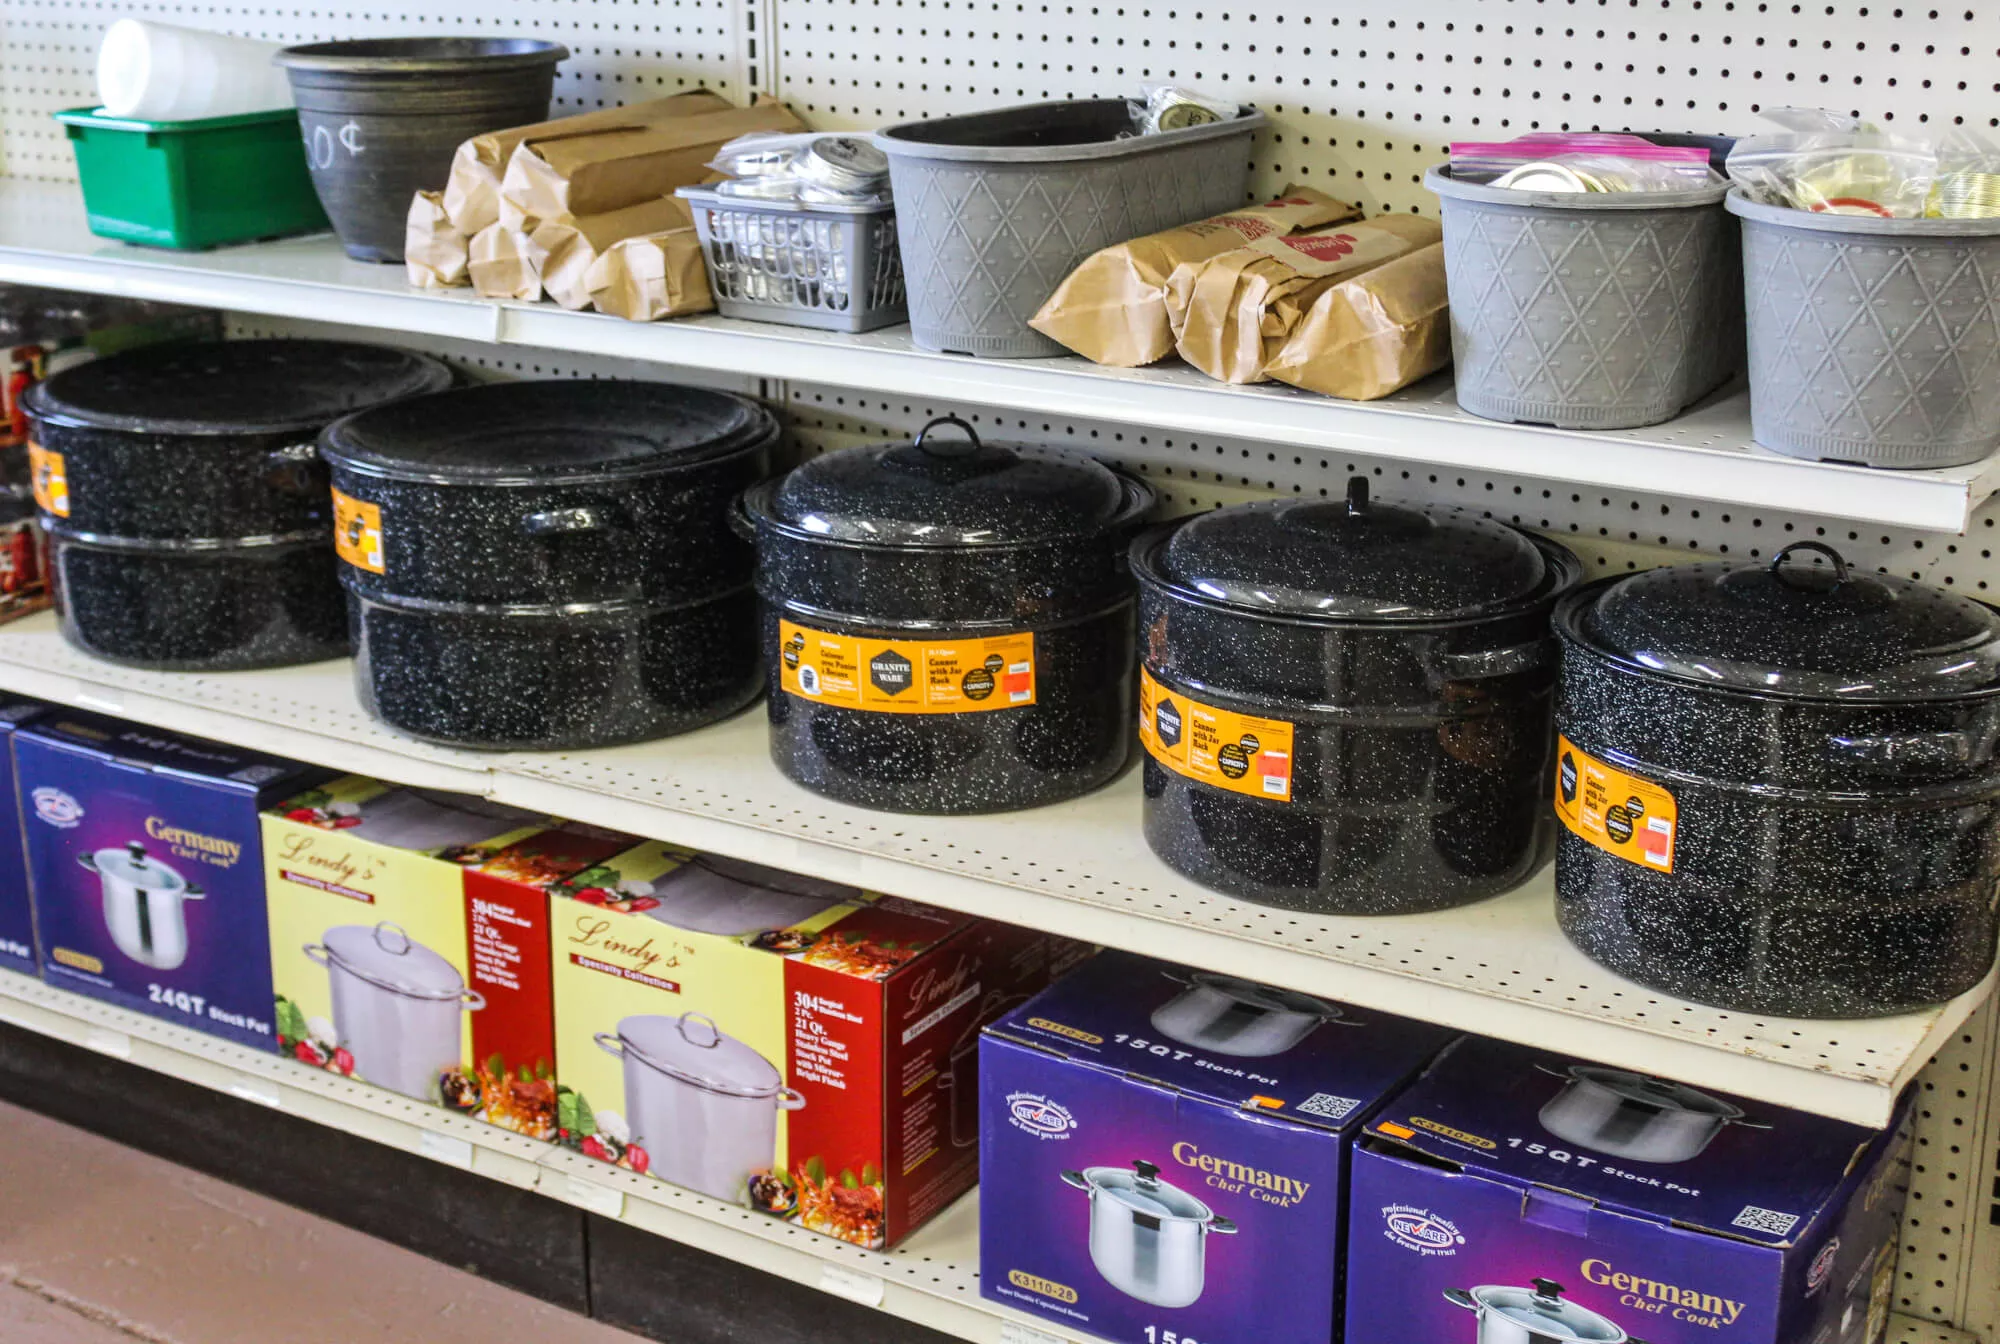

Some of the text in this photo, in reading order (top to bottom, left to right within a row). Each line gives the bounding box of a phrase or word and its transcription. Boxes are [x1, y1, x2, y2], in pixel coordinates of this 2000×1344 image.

[871, 662, 911, 672] GRANITE
[879, 673, 904, 683] WARE
[144, 815, 241, 860] Germany
[170, 844, 231, 869] Chef Cook
[278, 832, 375, 886] Lindy's
[567, 915, 681, 972] Lindy's
[577, 955, 674, 991] Specialty Collection
[147, 982, 271, 1036] 24QT Stock Pot
[794, 990, 819, 1012] 304
[795, 1016, 828, 1036] 21 Qt.
[1113, 1033, 1193, 1062] 15QT
[1194, 1059, 1243, 1079] Stock
[1246, 1073, 1280, 1087] Pot
[1040, 1131, 1053, 1141] you
[1172, 1141, 1311, 1204] Germany
[1414, 1118, 1490, 1147] K3110-28
[1506, 1137, 1599, 1168] 15QT
[1602, 1166, 1661, 1187] Stock
[1665, 1182, 1701, 1198] Pot
[1205, 1175, 1290, 1208] Chef Cook
[1383, 1229, 1457, 1257] the brand you trust
[1013, 1271, 1074, 1301] K3110-28
[1580, 1257, 1747, 1325] Germany
[1619, 1293, 1722, 1329] Chef Cook
[1144, 1325, 1199, 1344] 15
